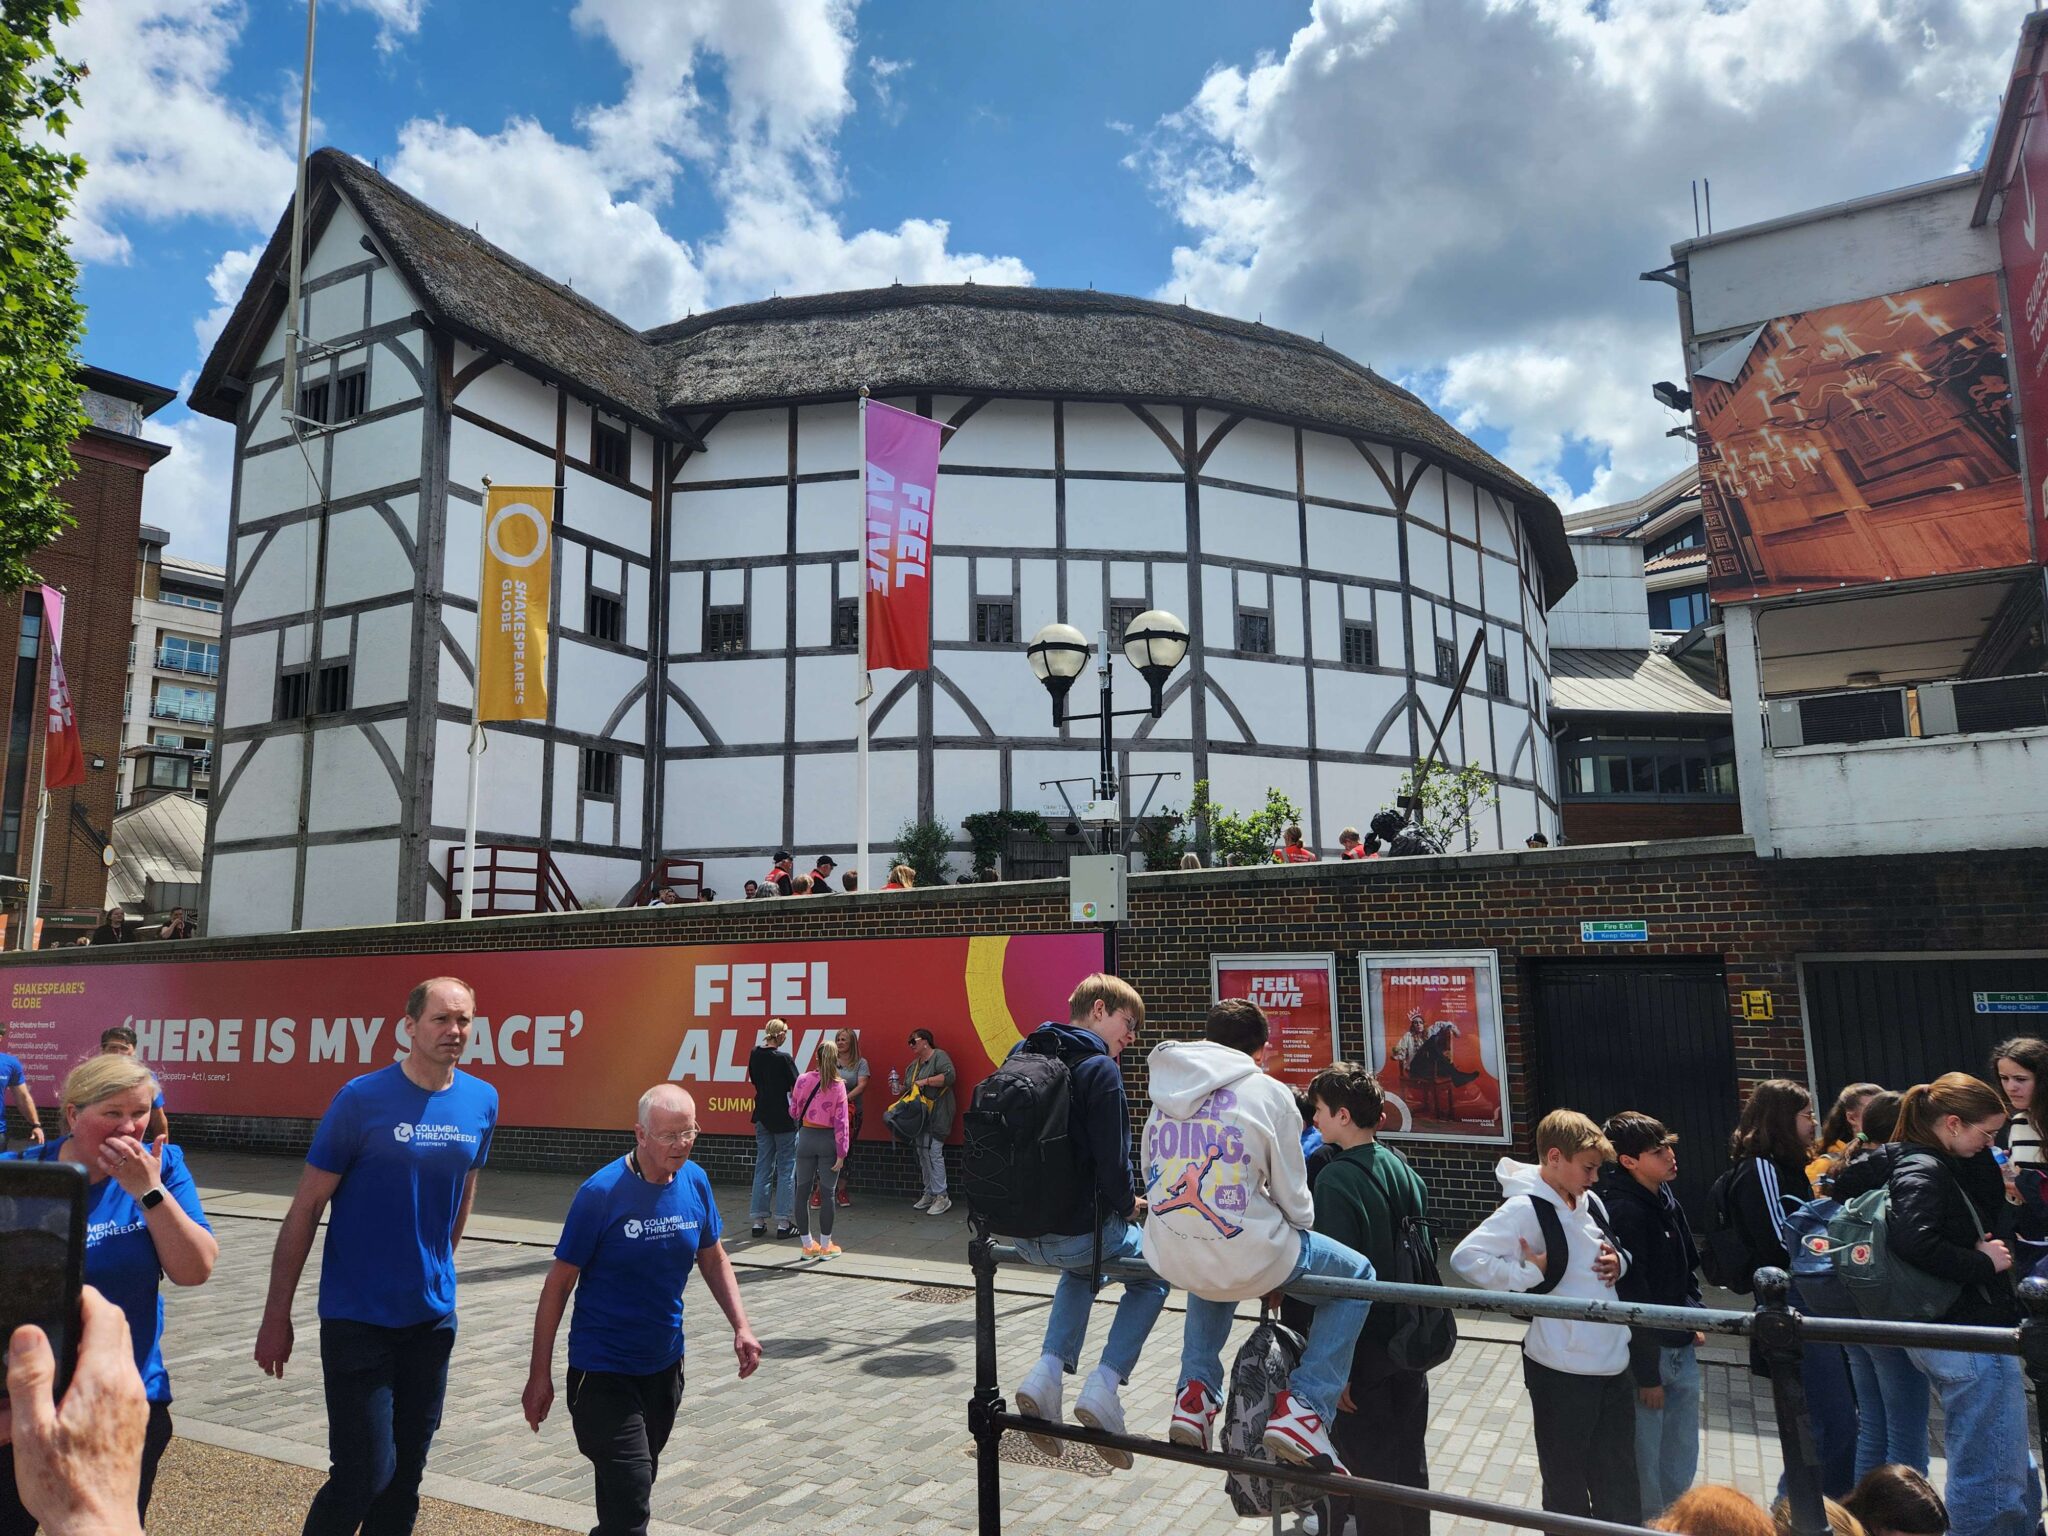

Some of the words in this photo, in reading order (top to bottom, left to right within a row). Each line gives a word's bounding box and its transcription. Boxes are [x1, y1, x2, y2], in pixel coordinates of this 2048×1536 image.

[866, 460, 895, 597] ALIVE
[896, 482, 931, 588] FEEL
[501, 579, 512, 633] GLOBE
[513, 579, 527, 705] SHAKESPEARE'S
[1251, 977, 1300, 992] FEEL
[1390, 975, 1449, 985] RICHARD
[1452, 975, 1466, 985] III
[13, 982, 86, 995] SHAKESPEARE'S
[694, 961, 846, 1016] FEEL
[11, 997, 42, 1009] GLOBE
[9, 1031, 24, 1039] Guided
[252, 1017, 297, 1064] IS
[308, 1017, 385, 1064] MY
[393, 1009, 584, 1067] SACE’
[158, 1071, 186, 1081] Cleopatra
[191, 1072, 202, 1081] Act
[708, 1097, 752, 1113] SUMM
[415, 1124, 460, 1134] COLUMBIA
[416, 1132, 477, 1143] THREADNEEDLE
[86, 1219, 117, 1233] MBIA
[643, 1215, 684, 1227] COLUMBIA
[645, 1220, 698, 1235] THREADNEEDLE
